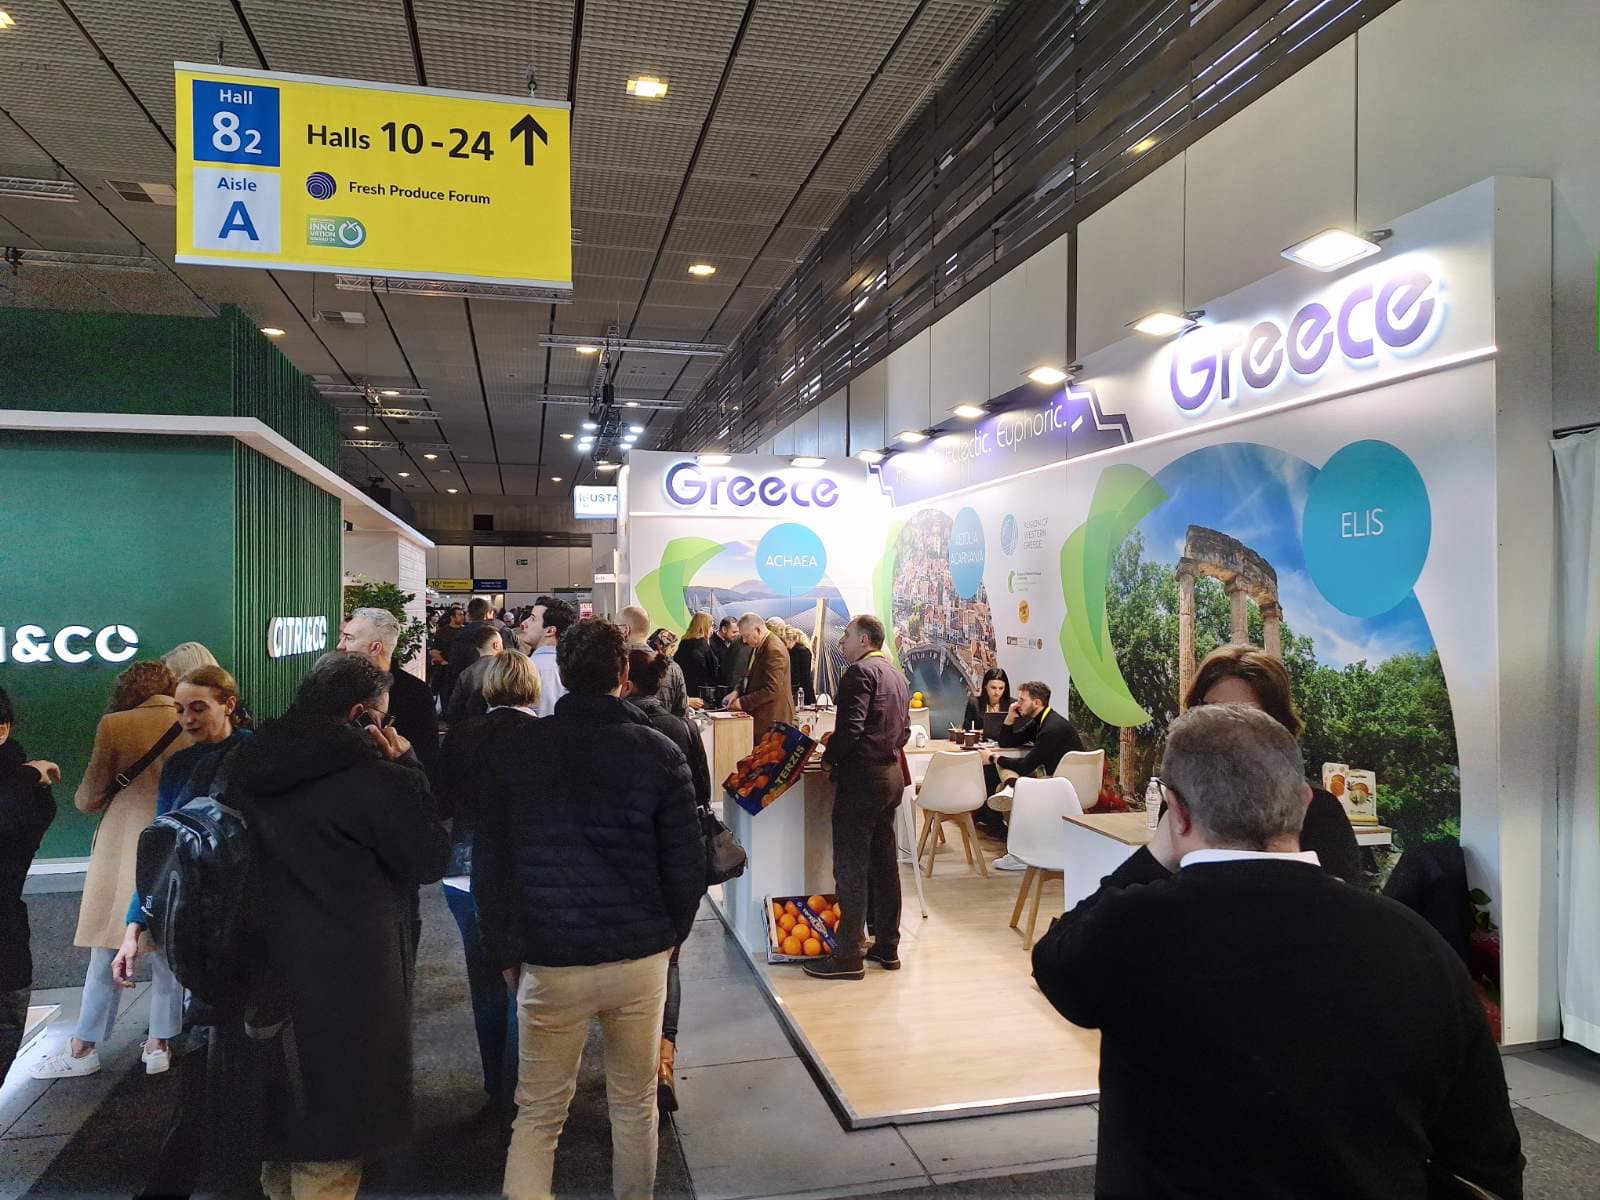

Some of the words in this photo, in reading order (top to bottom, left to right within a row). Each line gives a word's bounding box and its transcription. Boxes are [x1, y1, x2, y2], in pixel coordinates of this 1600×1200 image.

[219, 89, 253, 105] Hall
[307, 124, 371, 150] Halls
[216, 176, 257, 192] Aisle
[348, 181, 386, 196] Fresh
[389, 184, 445, 201] Produce
[448, 188, 491, 205] Forum
[217, 200, 260, 241] A
[309, 223, 336, 232] INNO
[1168, 270, 1436, 411] Greece
[996, 401, 1067, 453] Euphoric.
[665, 461, 840, 508] Greece
[1341, 508, 1385, 538] ELIS
[765, 554, 819, 568] ACHAEA
[269, 616, 328, 658] CITRI&CO
[774, 745, 805, 784] TERZIS
